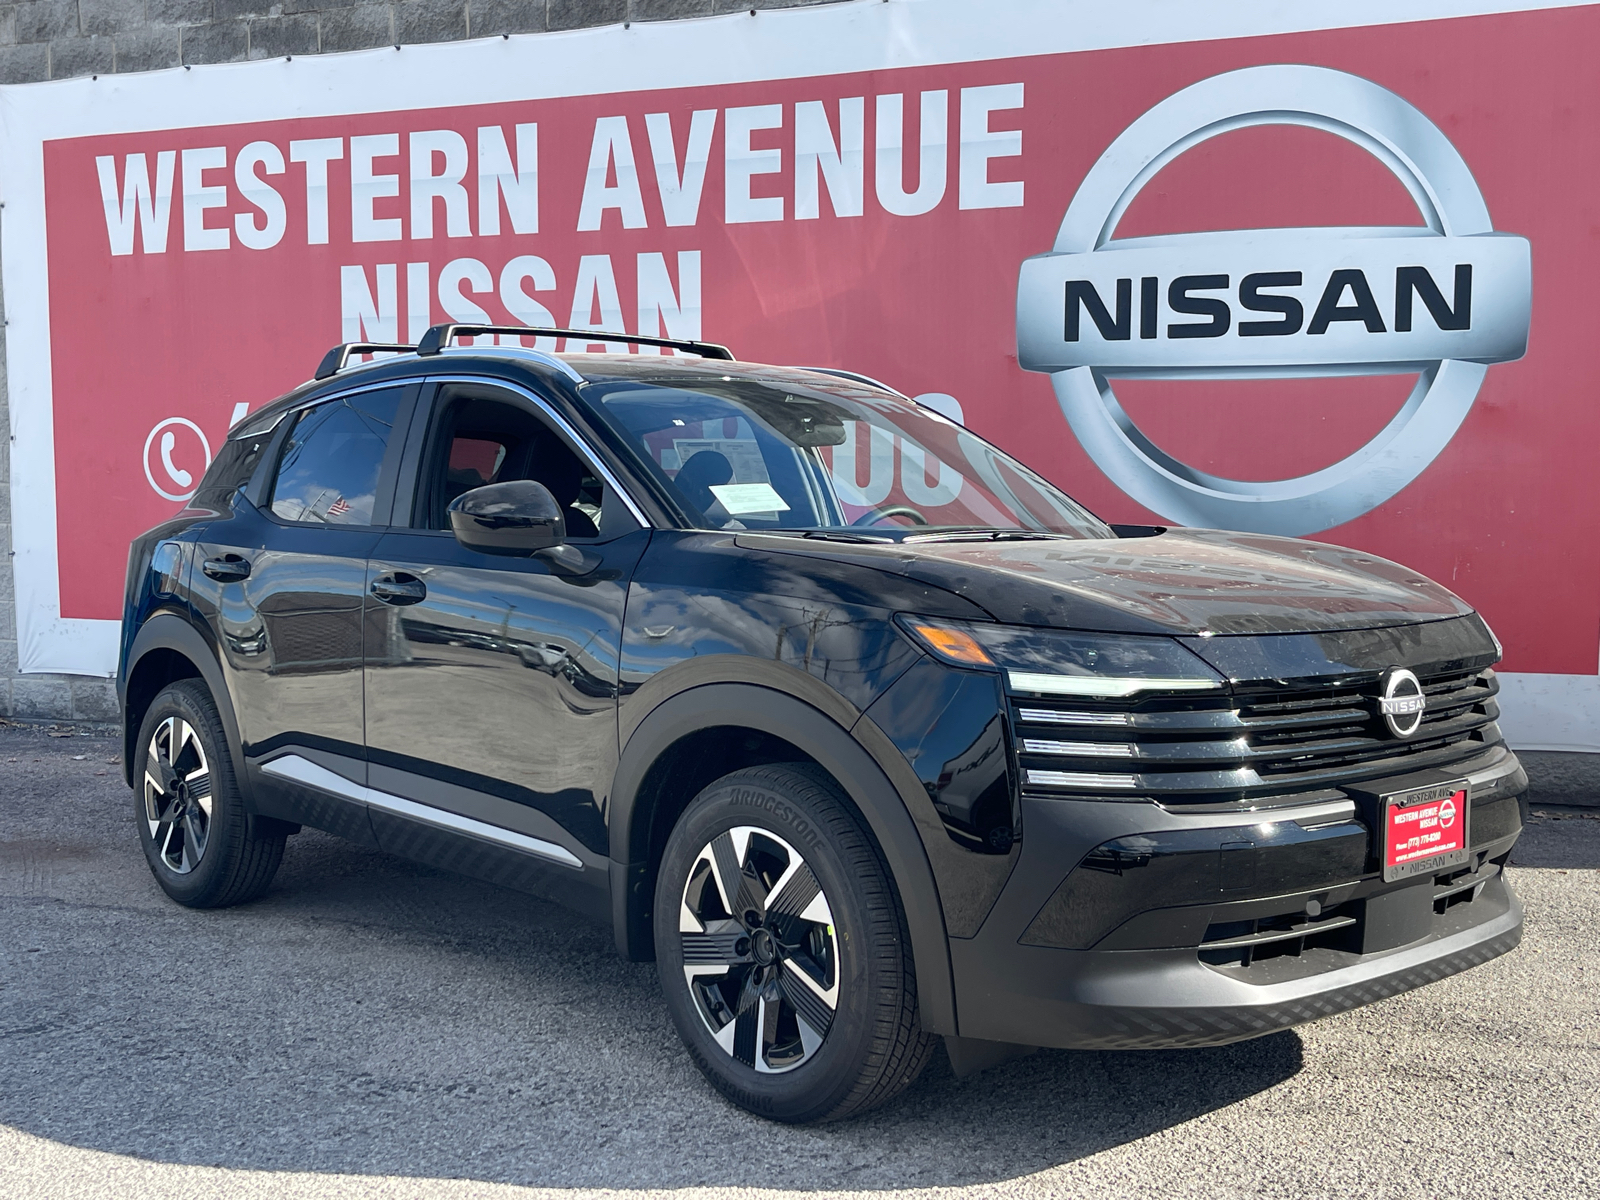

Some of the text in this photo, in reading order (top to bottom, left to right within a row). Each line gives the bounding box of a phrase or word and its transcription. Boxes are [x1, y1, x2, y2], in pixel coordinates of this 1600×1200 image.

[96, 82, 1025, 256] WESTERN AVENUE
[341, 250, 702, 364] NISSAN
[1064, 263, 1473, 342] NISSAN
[1383, 698, 1426, 714] NISSAN
[1406, 790, 1437, 804] WESTERN
[728, 788, 826, 854] BRIDGESTONE
[1394, 806, 1438, 825] WESTERN AVENUE
[1419, 816, 1438, 829] NISSAN
[1409, 855, 1446, 874] NISSAN
